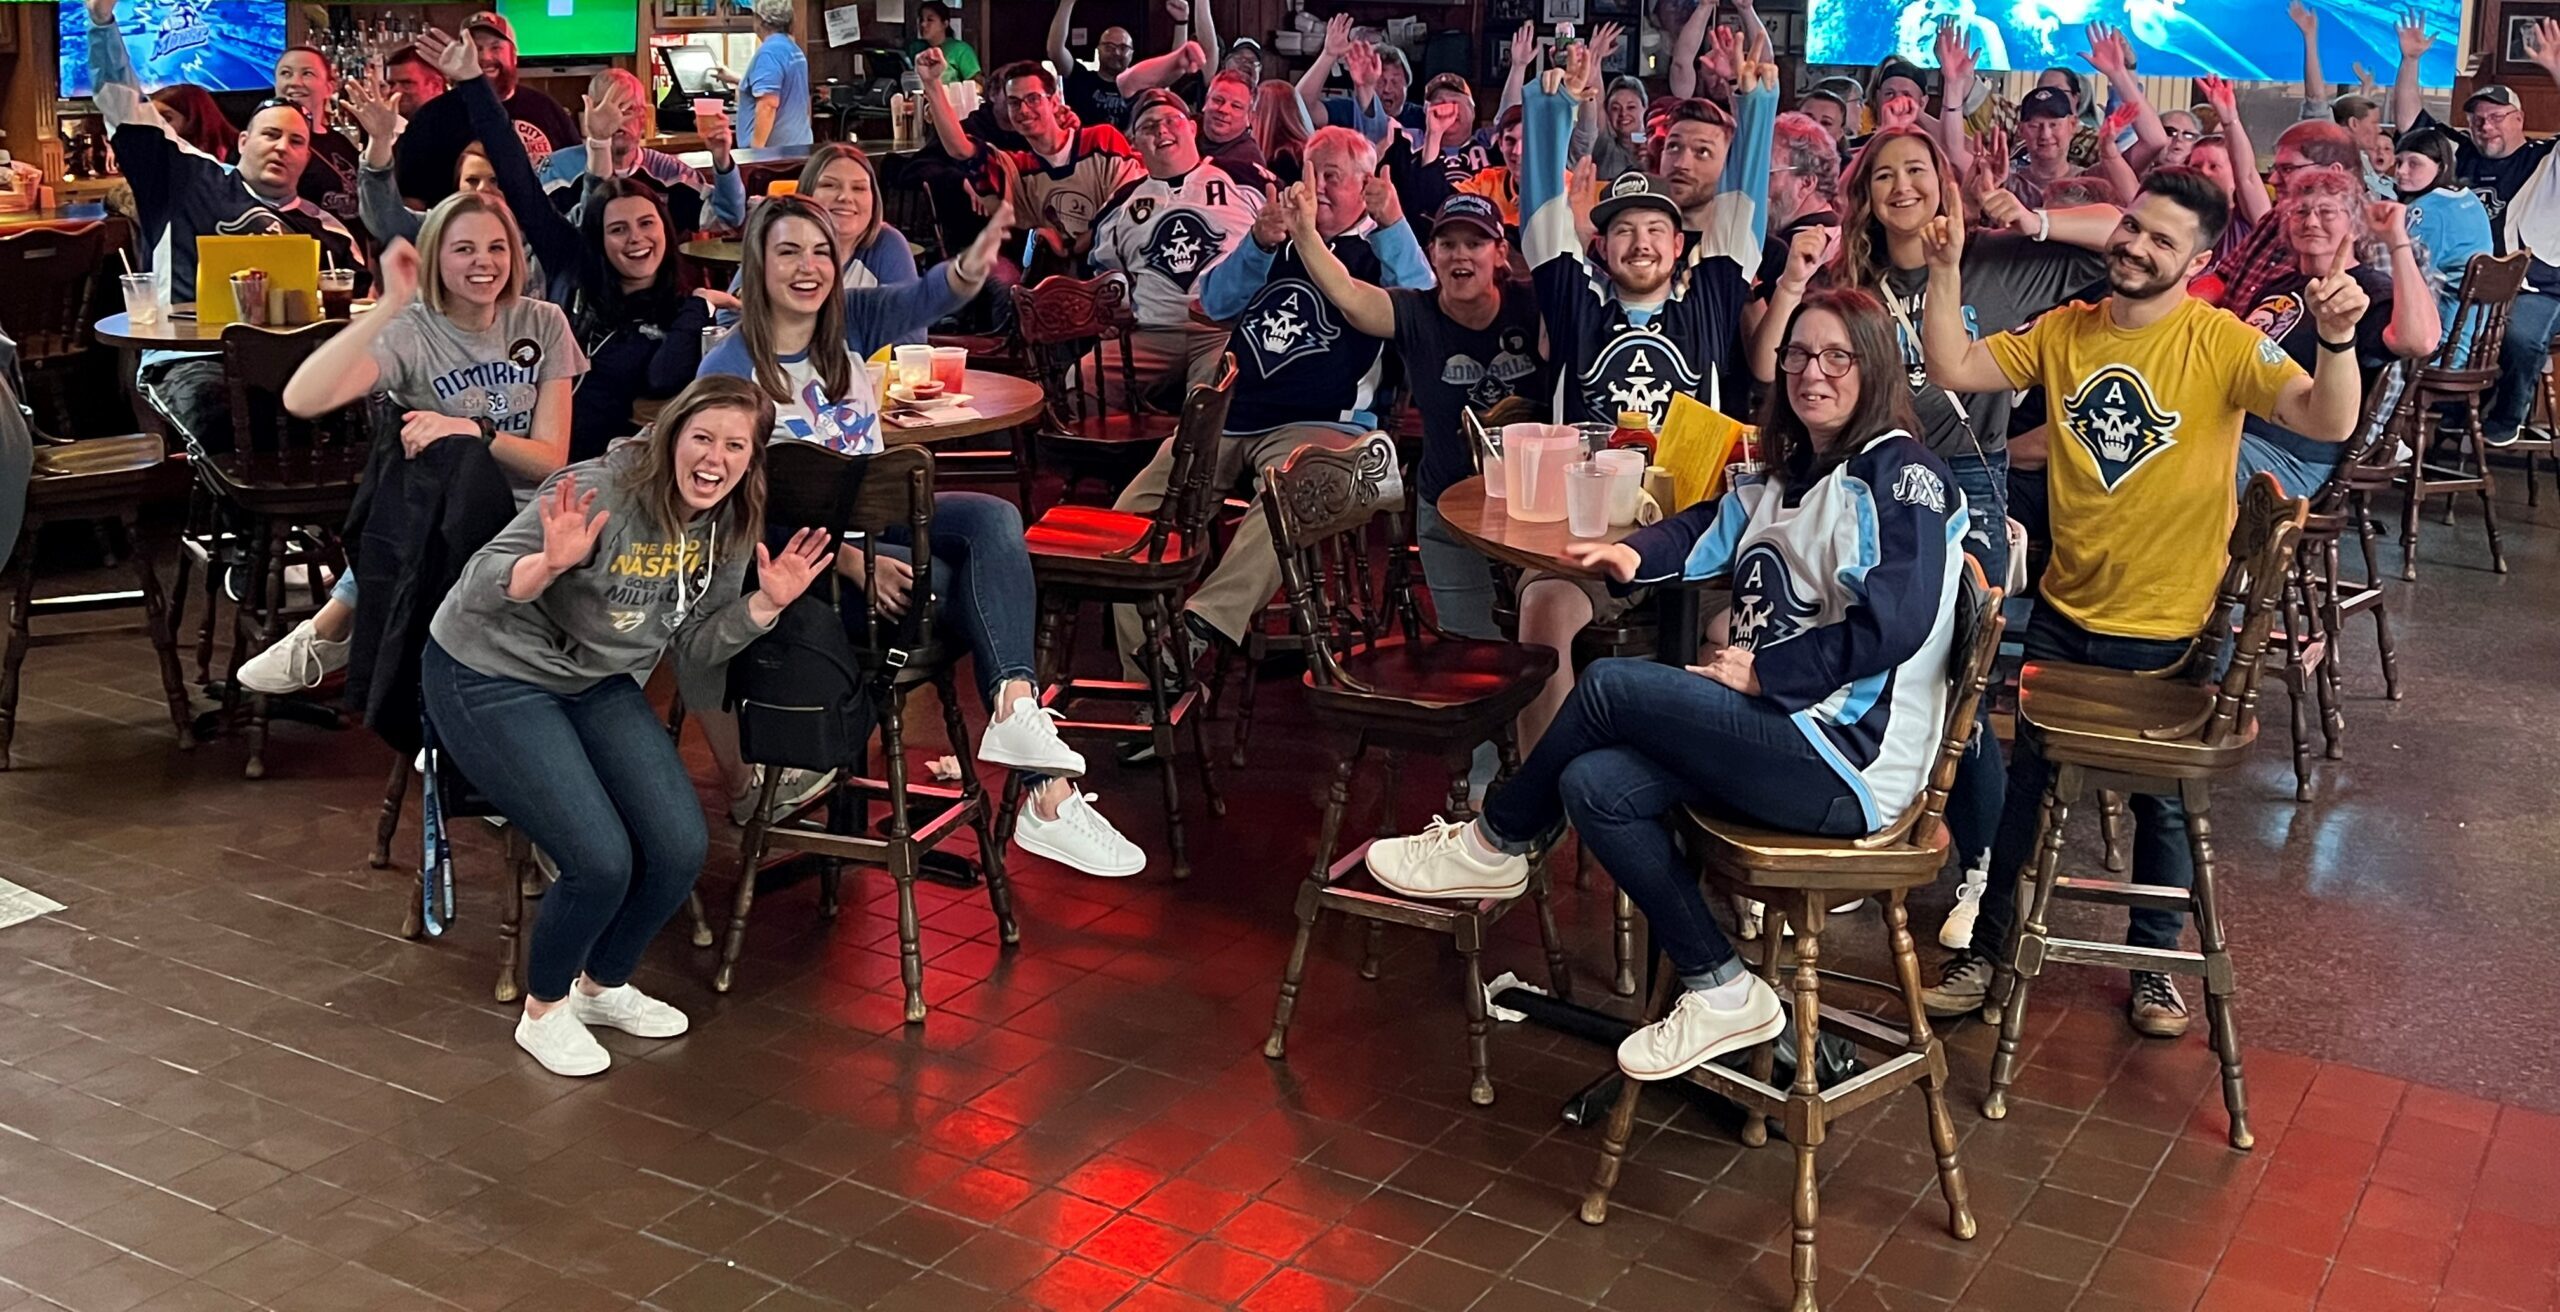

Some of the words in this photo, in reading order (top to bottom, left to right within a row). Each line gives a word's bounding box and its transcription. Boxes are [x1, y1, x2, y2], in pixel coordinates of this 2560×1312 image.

[518, 123, 542, 139] CITY
[1206, 180, 1228, 206] A
[1171, 219, 1188, 236] A
[1281, 292, 1299, 311] A
[1627, 349, 1654, 373] A
[2104, 381, 2126, 405] A
[631, 542, 659, 556] THE
[662, 540, 700, 556] ROD
[625, 577, 660, 591] GOES
[1744, 560, 1763, 589] A
